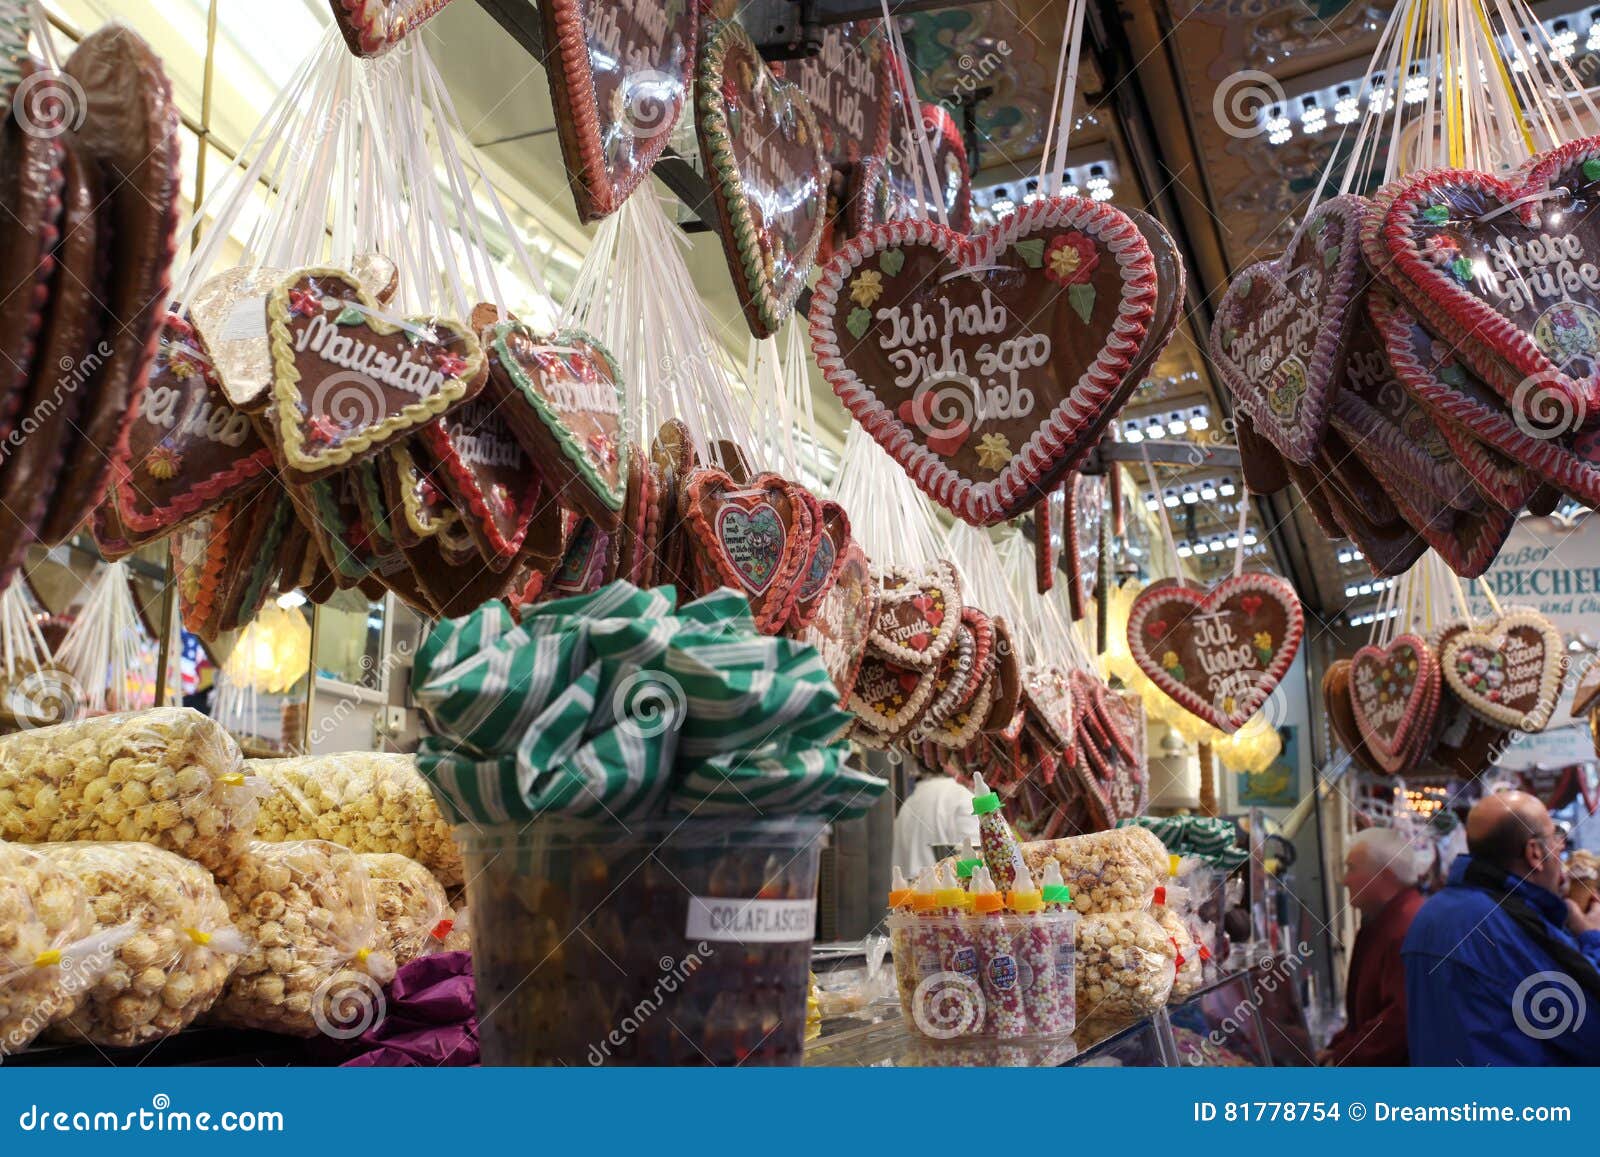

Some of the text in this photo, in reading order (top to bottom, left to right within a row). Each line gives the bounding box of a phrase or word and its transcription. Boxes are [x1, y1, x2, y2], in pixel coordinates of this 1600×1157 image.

[1490, 234, 1584, 272] Liebe
[1487, 260, 1600, 312] Grüße
[876, 289, 1007, 349] Ich hab
[888, 333, 1052, 388] Dich sooo
[971, 371, 1035, 421] lieb
[1494, 545, 1552, 567] roßer
[1193, 616, 1237, 648] Ich
